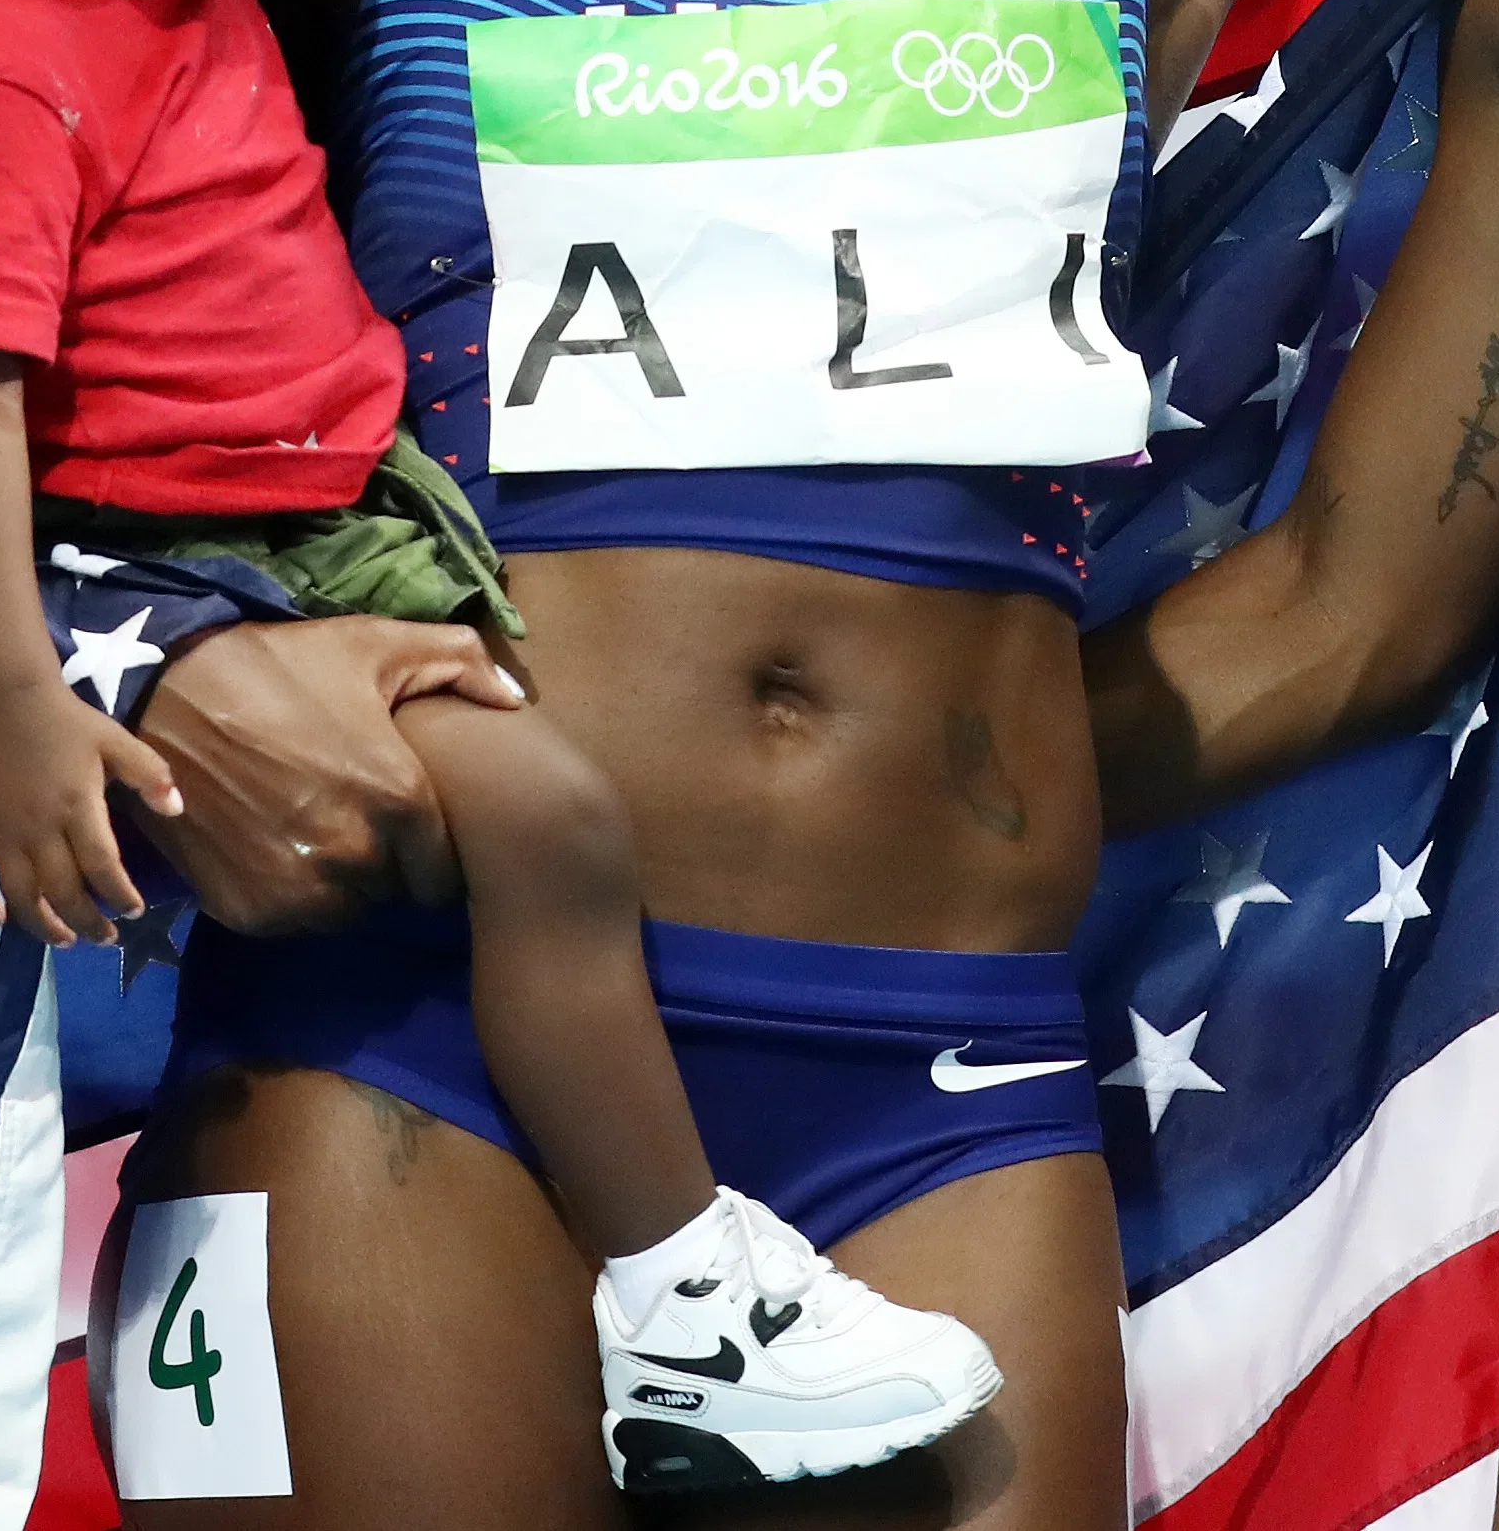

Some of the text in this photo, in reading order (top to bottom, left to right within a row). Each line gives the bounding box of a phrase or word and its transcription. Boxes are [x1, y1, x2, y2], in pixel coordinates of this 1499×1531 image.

[575, 42, 849, 118] Rio2016
[148, 1256, 222, 1427] 4
[646, 1392, 699, 1406] AIR MAX
